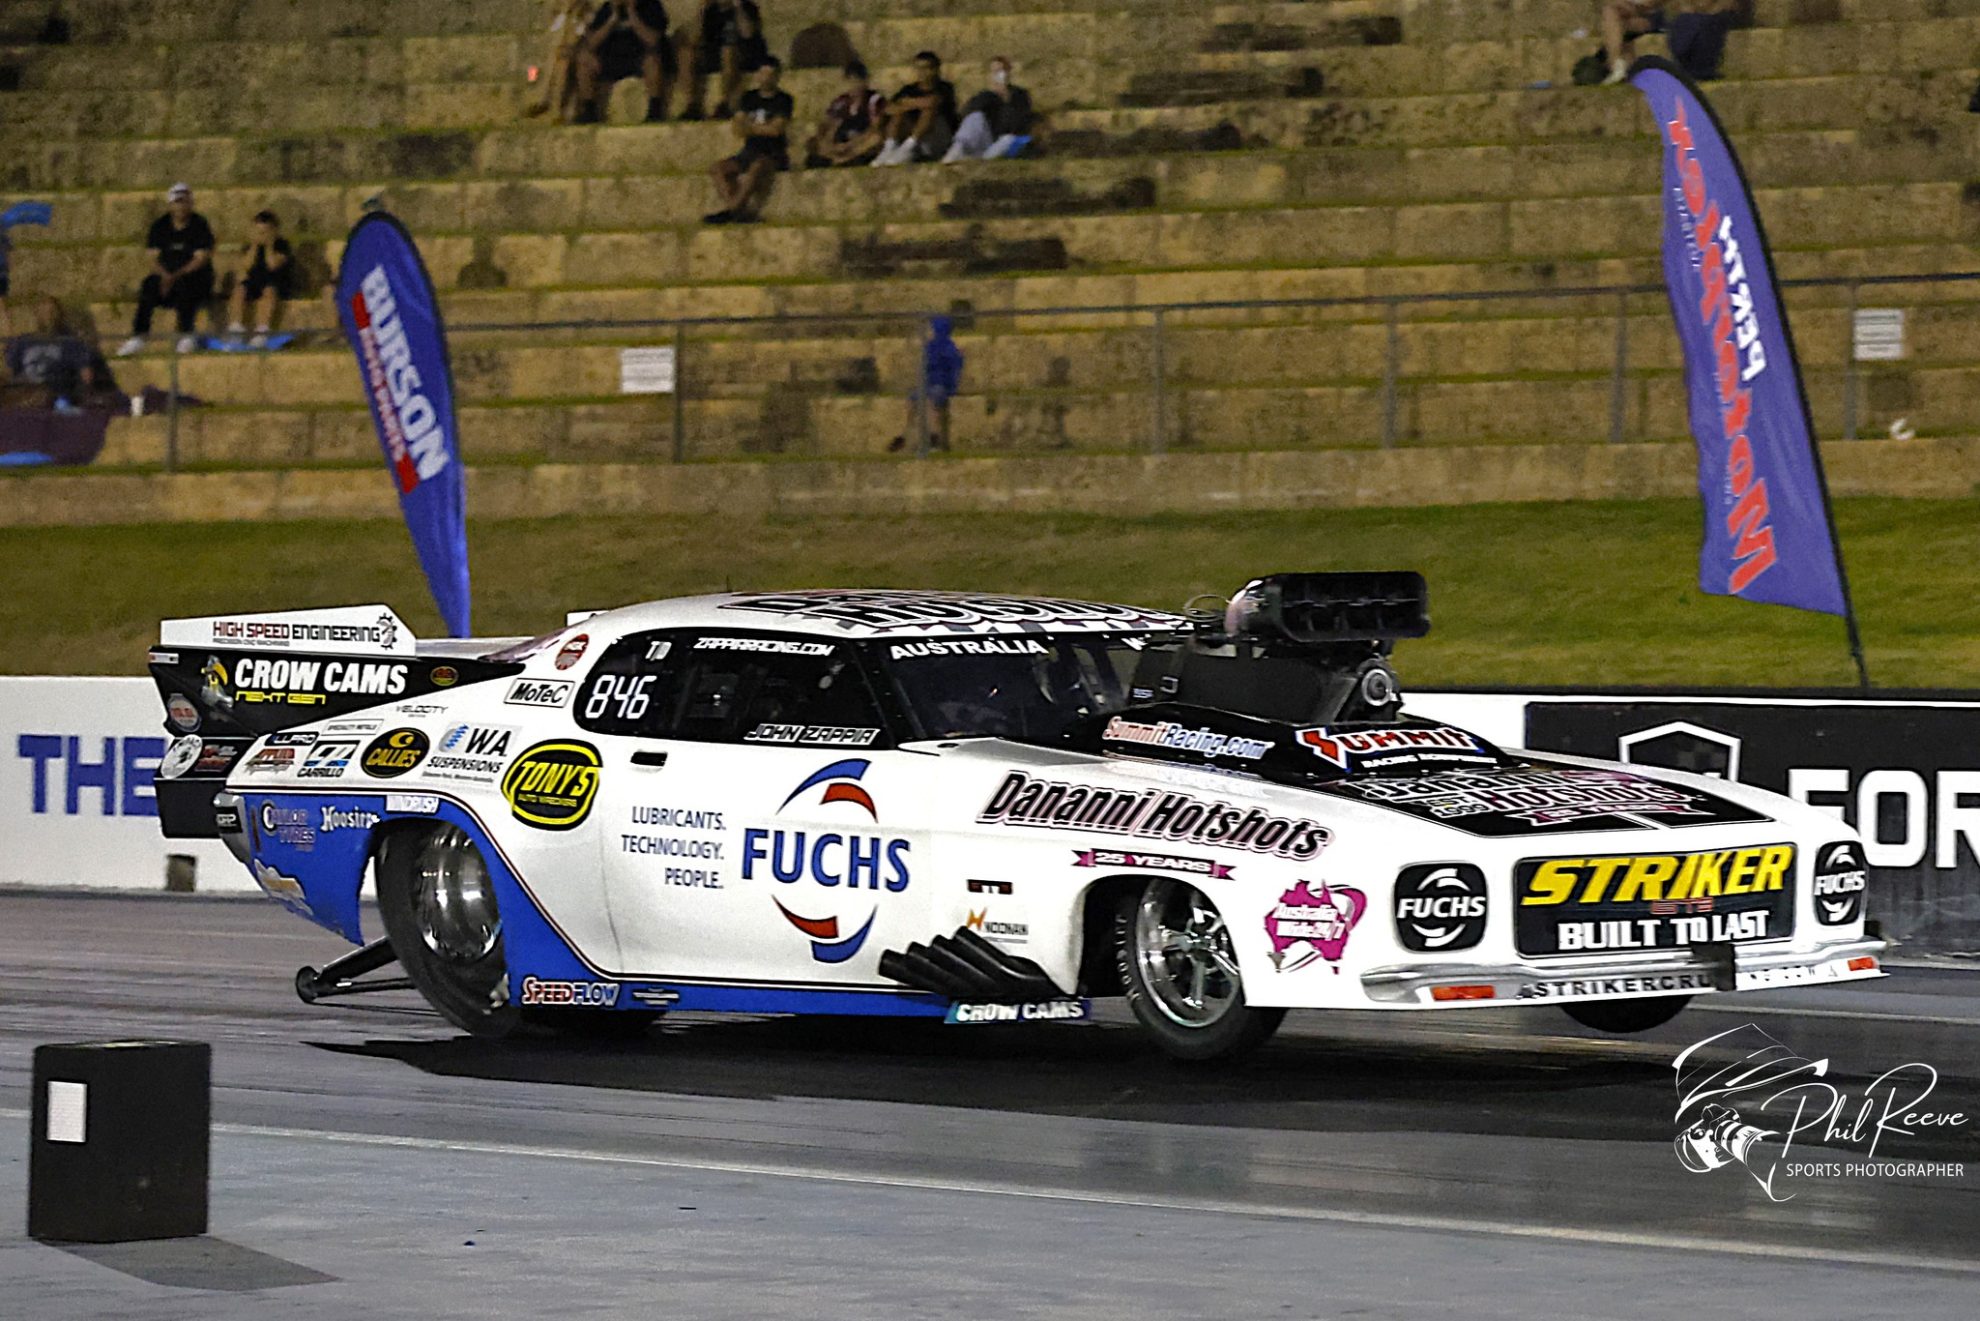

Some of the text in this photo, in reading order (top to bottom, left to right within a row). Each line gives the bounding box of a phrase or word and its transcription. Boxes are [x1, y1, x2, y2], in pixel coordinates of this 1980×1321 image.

[361, 264, 449, 481] BURSON
[213, 621, 380, 643] HIGH SPEED ENGINEERING
[645, 640, 672, 660] TD
[890, 639, 1049, 660] AUSTRALIA
[235, 658, 321, 691] CROW
[324, 662, 408, 695] CAMS
[510, 683, 569, 704] MoTeC
[585, 675, 657, 719] 846
[744, 723, 880, 745] JOHN ZAPPIA
[1102, 716, 1275, 760] SummitRacing.com
[366, 747, 422, 768] CALLIES
[427, 756, 504, 774] SUSPENSIONS
[19, 734, 166, 815] THE
[297, 768, 345, 778] CARRILLO
[632, 806, 726, 830] LUBRICANTS.
[976, 770, 1334, 861] Dananni Hotshots
[621, 834, 725, 860] TECHNOLOGY.
[741, 827, 911, 893] FUCHS
[1095, 852, 1212, 872] 25 YEARS
[665, 867, 724, 889] PEOPLE.
[1521, 845, 1795, 906] STRIKER
[1814, 870, 1866, 896] FUCHS
[1397, 895, 1487, 920] FUCHS
[1558, 910, 1769, 951] BUILT TO LAST
[1535, 974, 1712, 998] STRIKERCRU
[956, 1001, 1084, 1022] CROW CAMS
